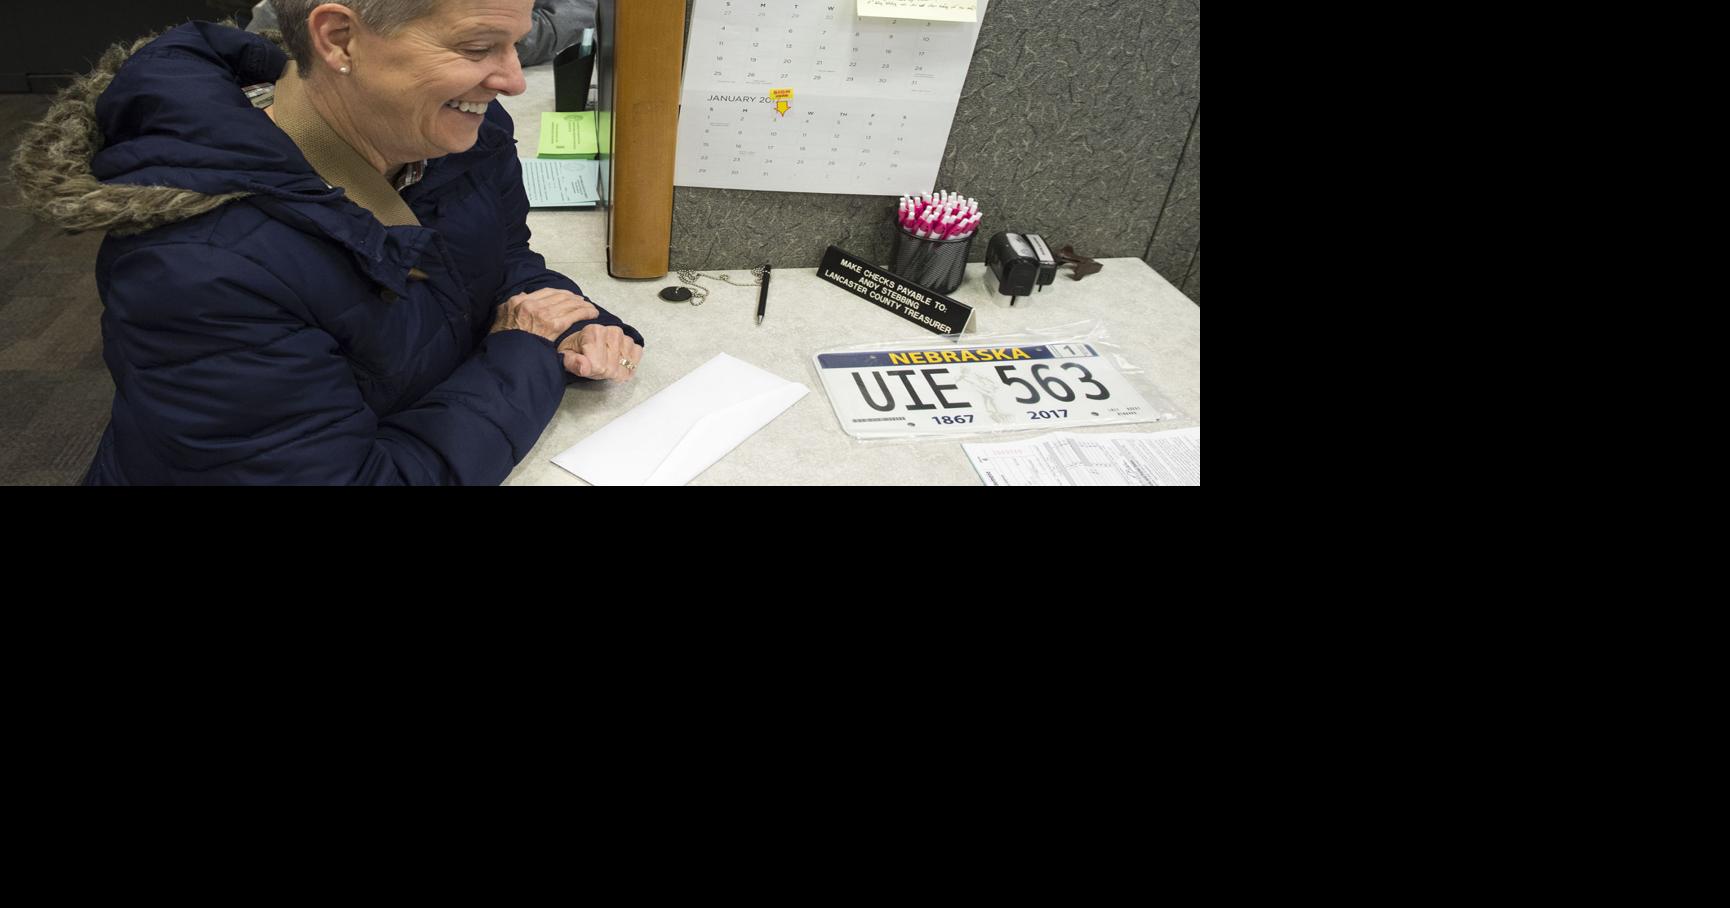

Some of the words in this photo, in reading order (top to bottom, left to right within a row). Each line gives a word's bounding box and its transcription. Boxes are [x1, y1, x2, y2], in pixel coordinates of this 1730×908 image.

[707, 95, 756, 103] JANUARY
[759, 96, 775, 104] 20
[840, 258, 862, 274] MAKE
[864, 269, 895, 288] CHECKS
[896, 284, 932, 305] PAYABLE
[934, 302, 948, 313] TO:
[858, 277, 879, 291] ANDY
[881, 287, 920, 310] STEBBING
[824, 269, 867, 295] LANCASTER
[869, 291, 901, 310] COUNTY
[903, 306, 952, 334] TREASURER
[888, 347, 1031, 365] NEBRASKA
[1063, 345, 1076, 355] 1
[851, 368, 972, 412] UIE
[994, 362, 1110, 404] 563
[932, 414, 974, 425] 1867
[1026, 409, 1068, 419] 2017
